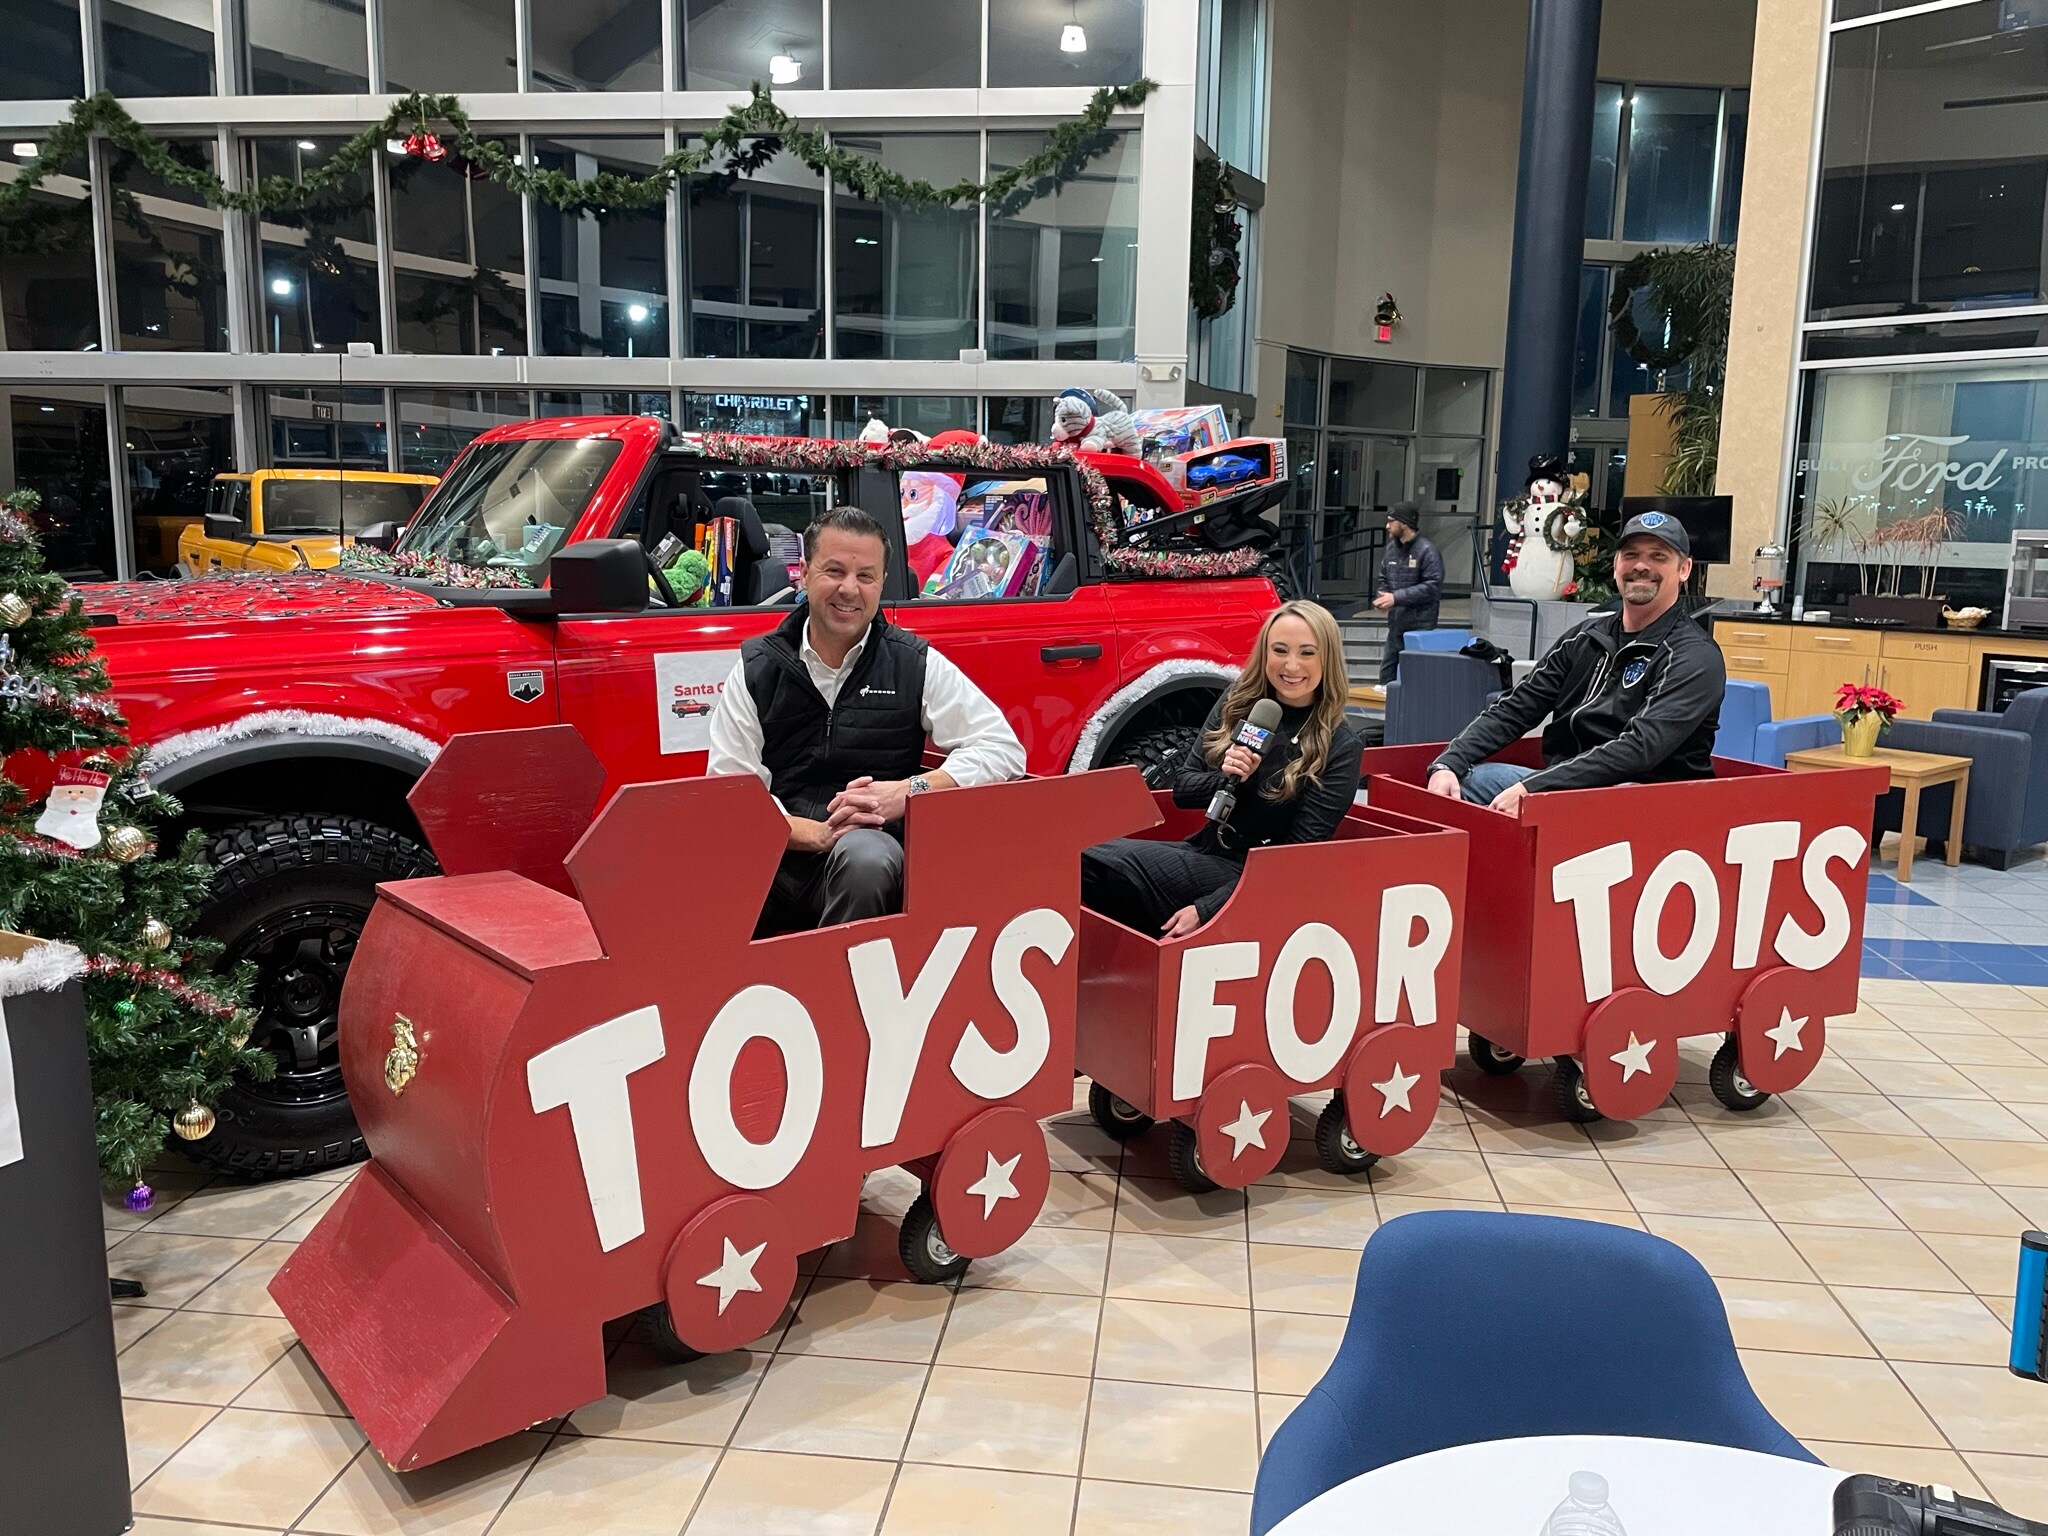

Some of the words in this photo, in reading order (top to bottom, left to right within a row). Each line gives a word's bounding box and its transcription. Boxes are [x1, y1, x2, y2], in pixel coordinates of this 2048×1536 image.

[1852, 433, 2008, 491] Ford
[1914, 642, 1938, 651] PUSH
[674, 683, 714, 697] Santa
[1242, 722, 1260, 736] FOX
[1236, 735, 1263, 749] NEWS
[527, 907, 1075, 1253] TOYS
[1173, 883, 1453, 1101] FOR
[1552, 821, 1868, 1003] TOTS
